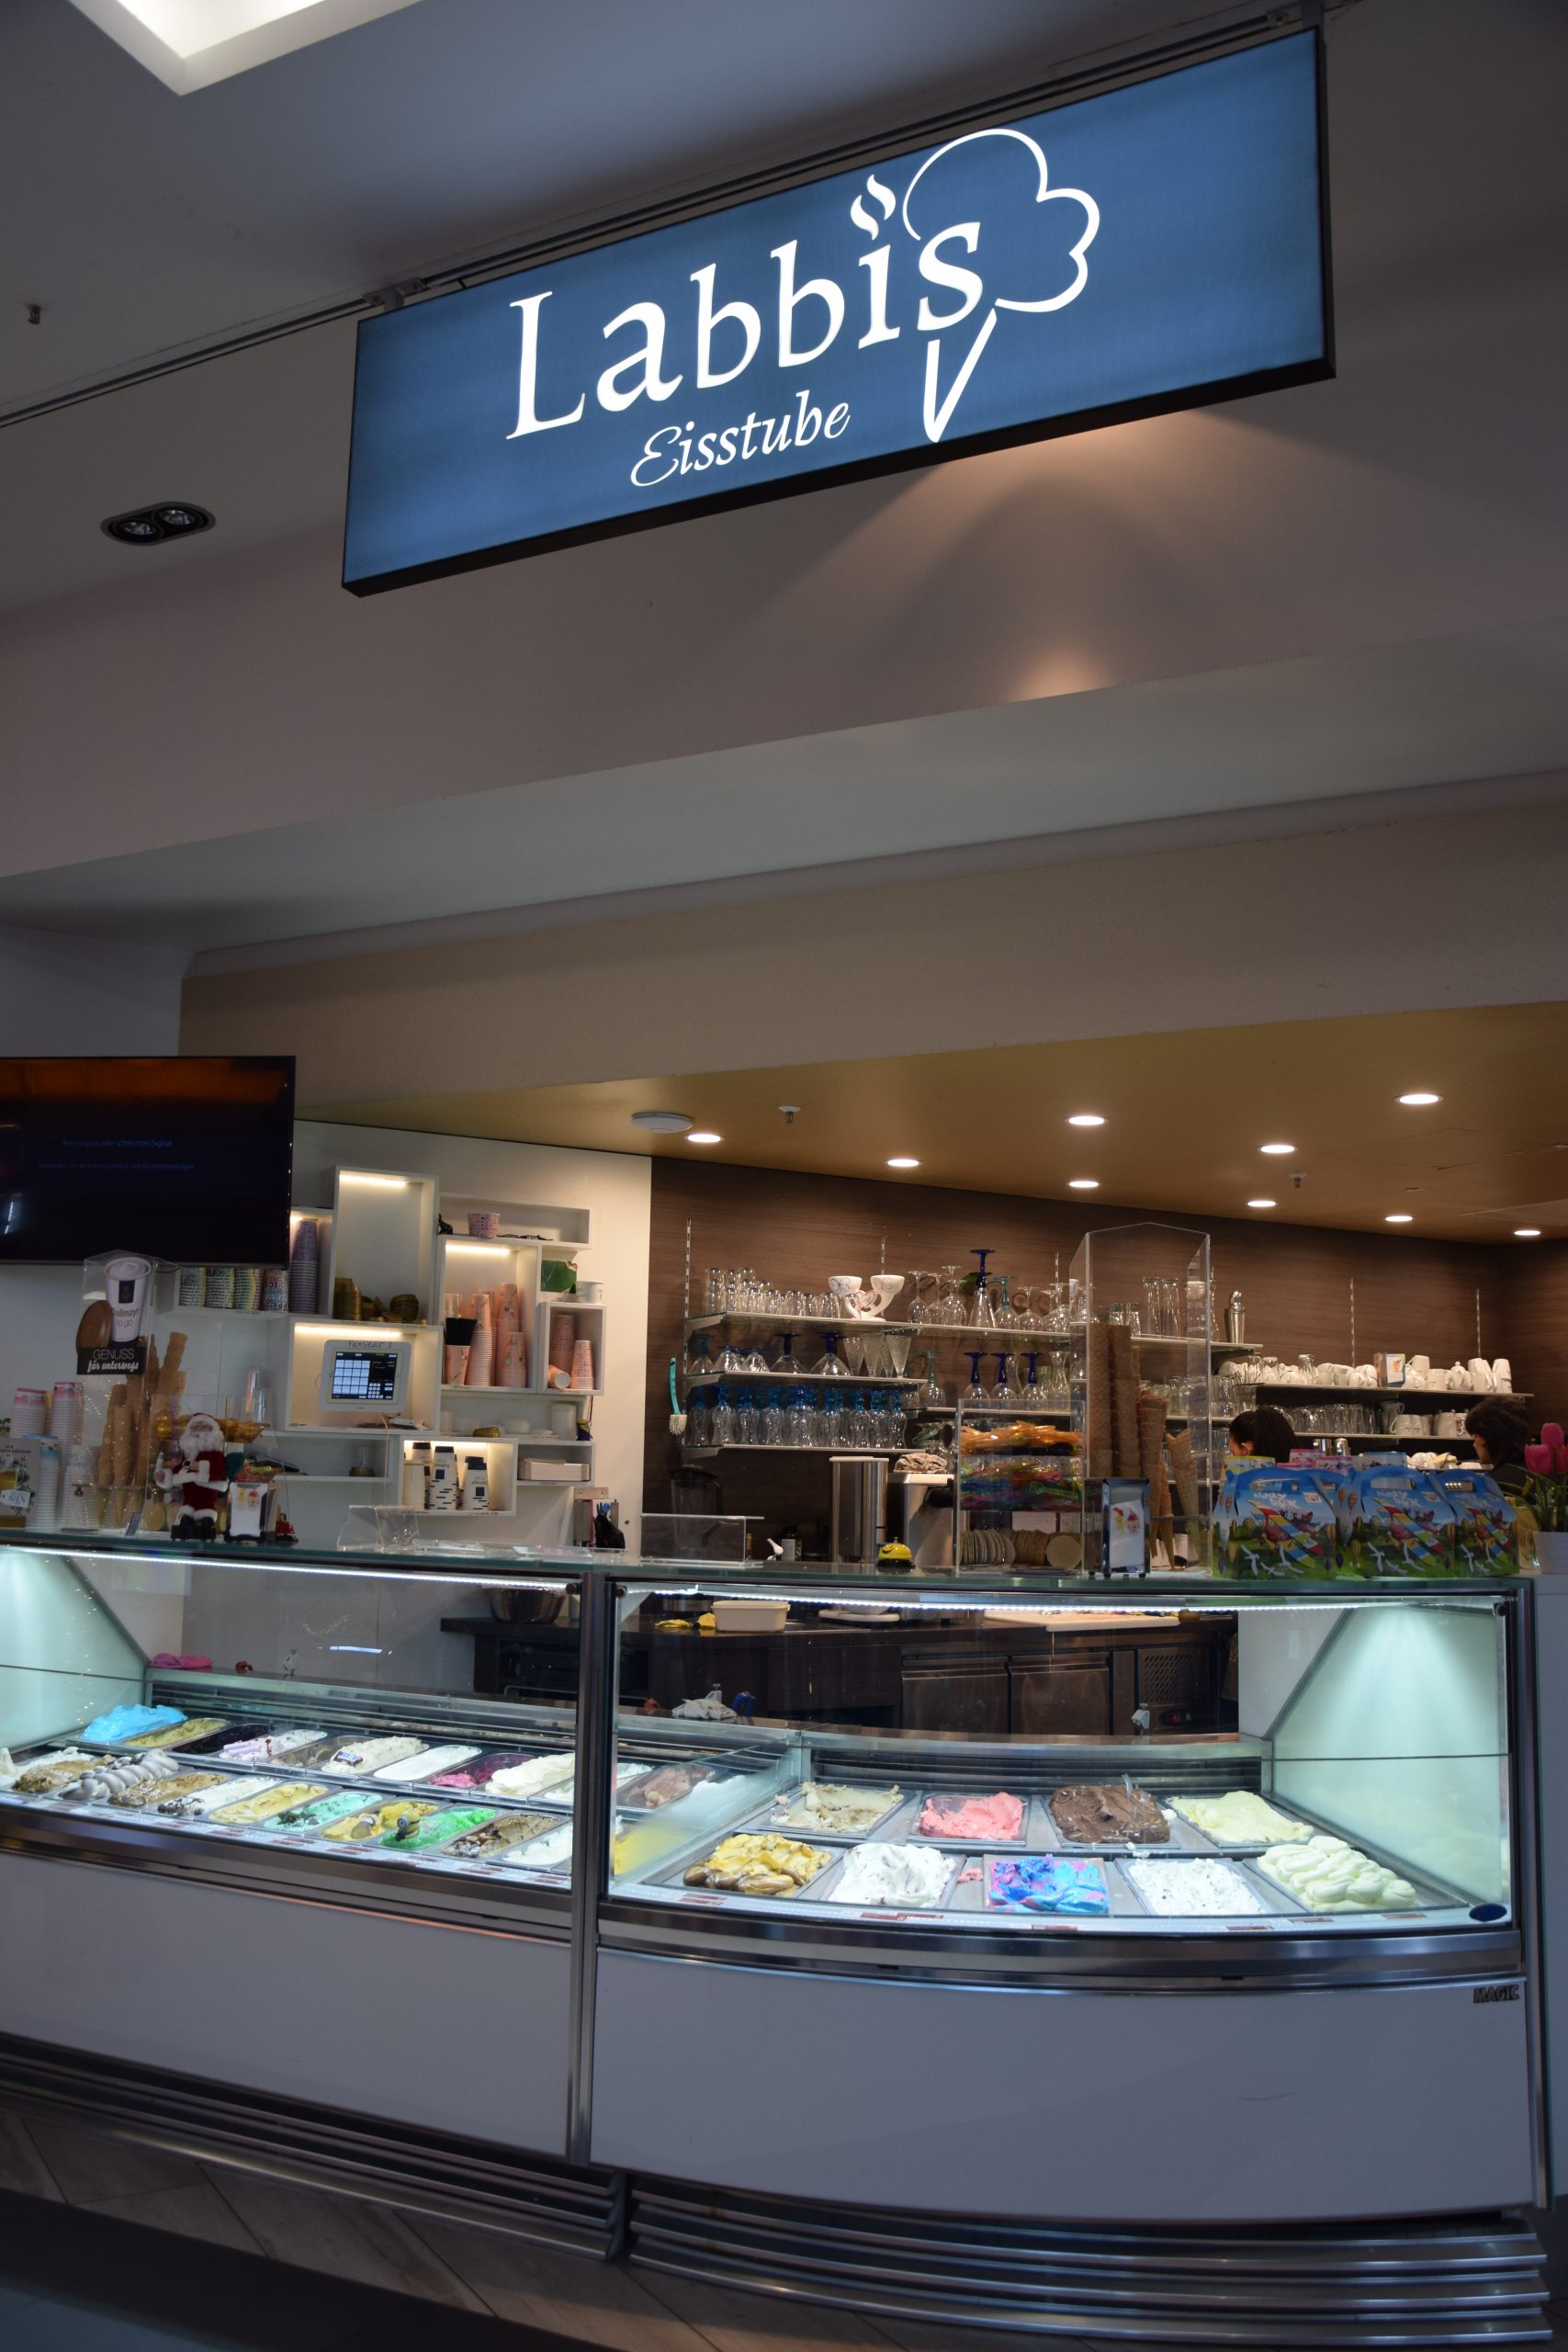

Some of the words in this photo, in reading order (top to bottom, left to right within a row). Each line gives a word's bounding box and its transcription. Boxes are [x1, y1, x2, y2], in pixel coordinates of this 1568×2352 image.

[506, 175, 986, 440] Labbis
[629, 391, 851, 487] Eisstube
[93, 1349, 135, 1360] GENUSS
[86, 1360, 100, 1374] für
[101, 1361, 140, 1373] unterwegs
[1473, 1984, 1520, 2004] MAGIC
